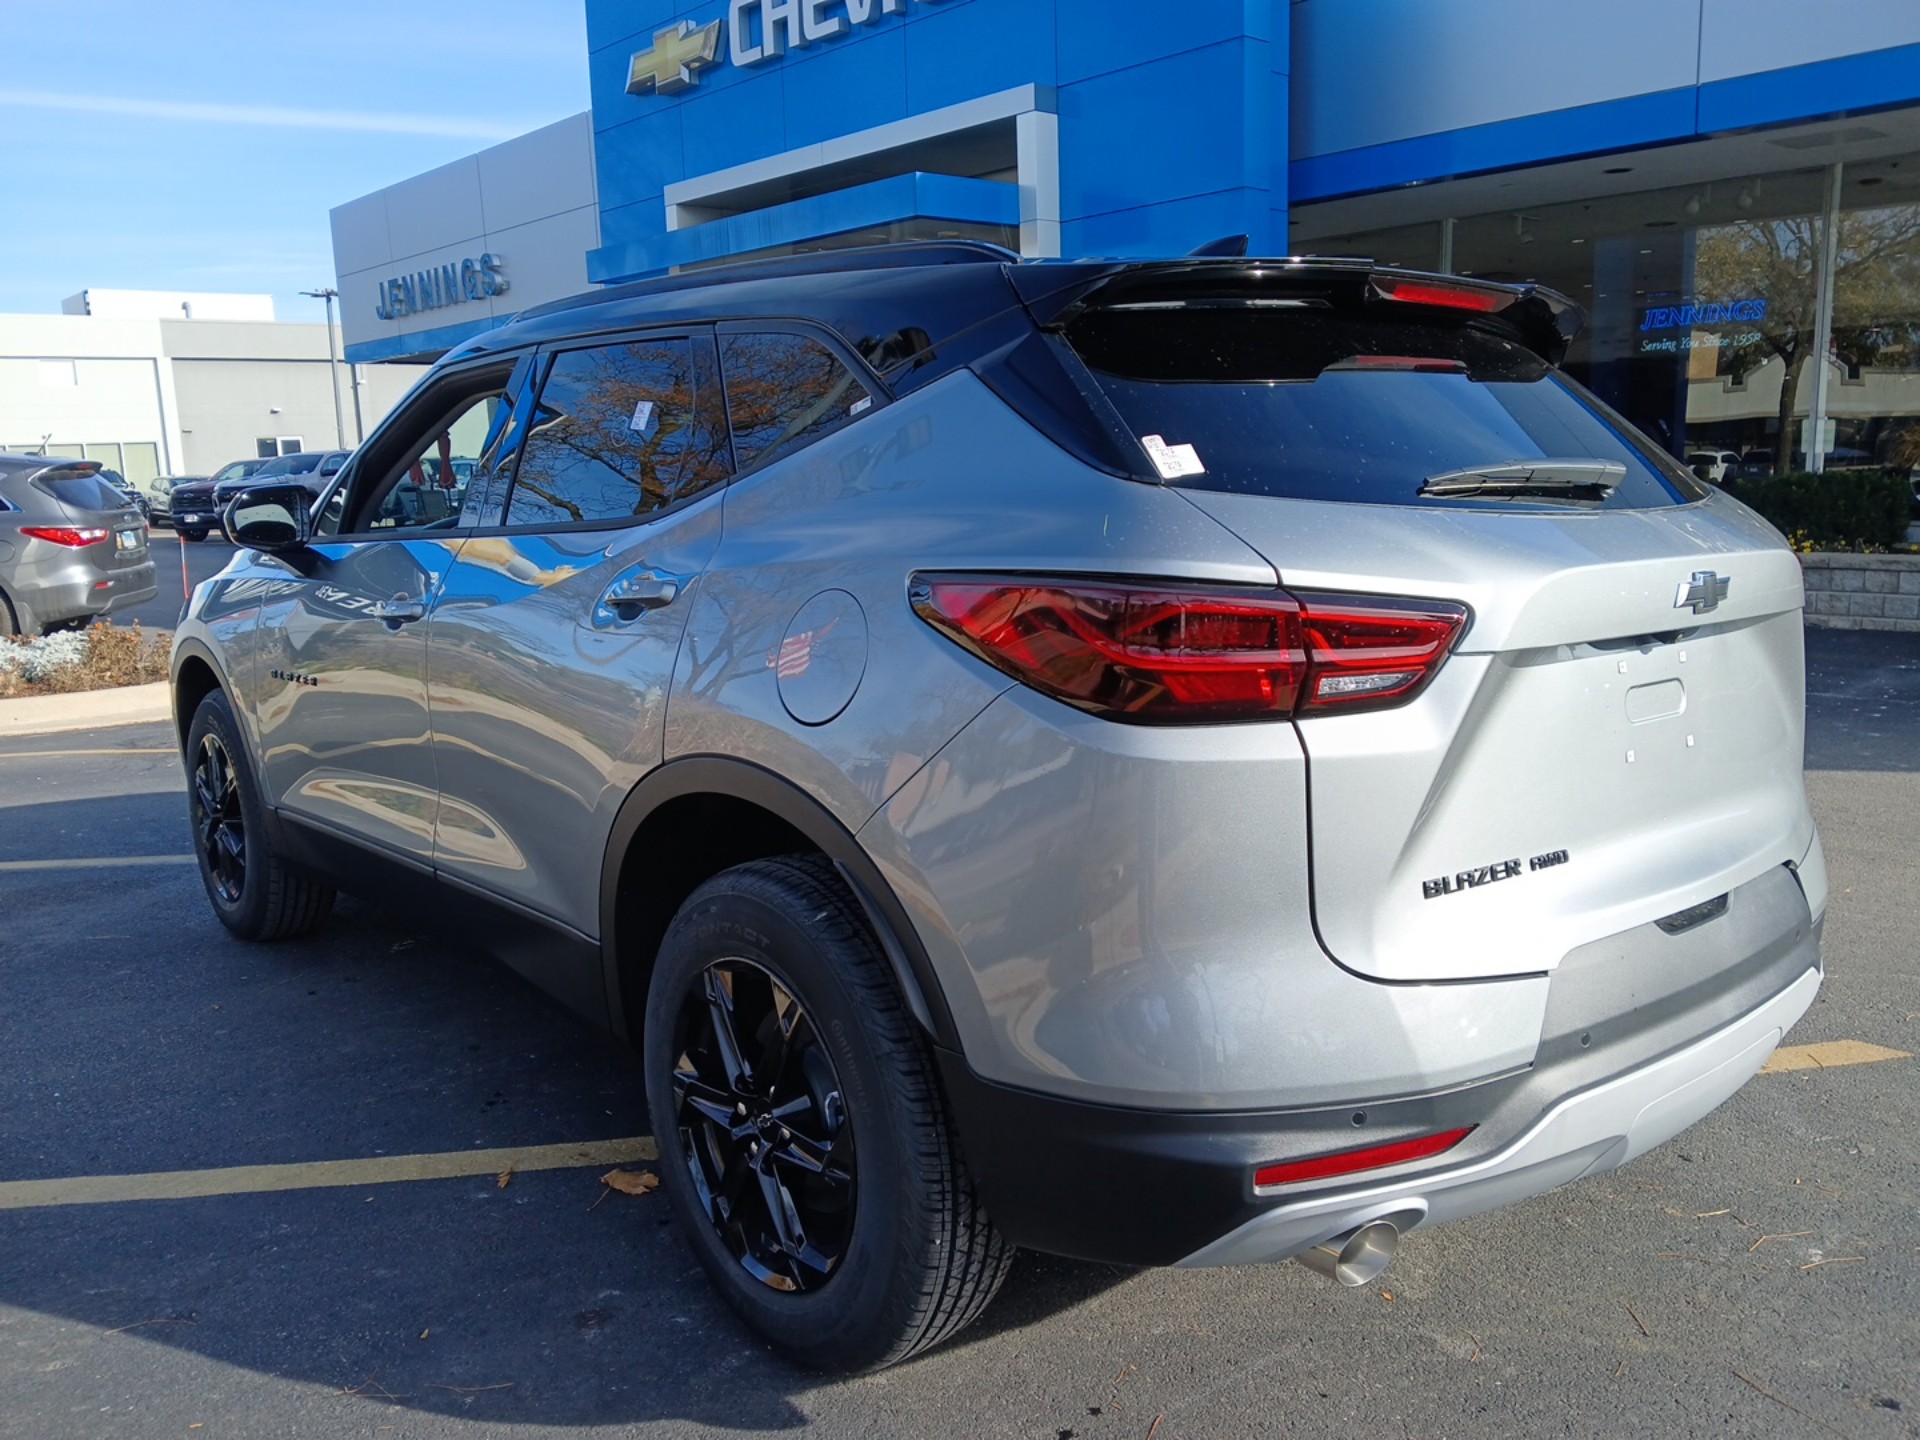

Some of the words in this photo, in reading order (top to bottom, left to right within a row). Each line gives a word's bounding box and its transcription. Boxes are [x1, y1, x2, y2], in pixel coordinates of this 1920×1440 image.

[728, 0, 904, 67] CHE
[375, 252, 504, 320] JENNINGS
[1640, 299, 1767, 332] JENNINGS
[1641, 338, 1677, 352] Serving
[1680, 336, 1700, 349] You
[1422, 858, 1522, 900] BLAZER
[1529, 849, 1569, 872] AWD
